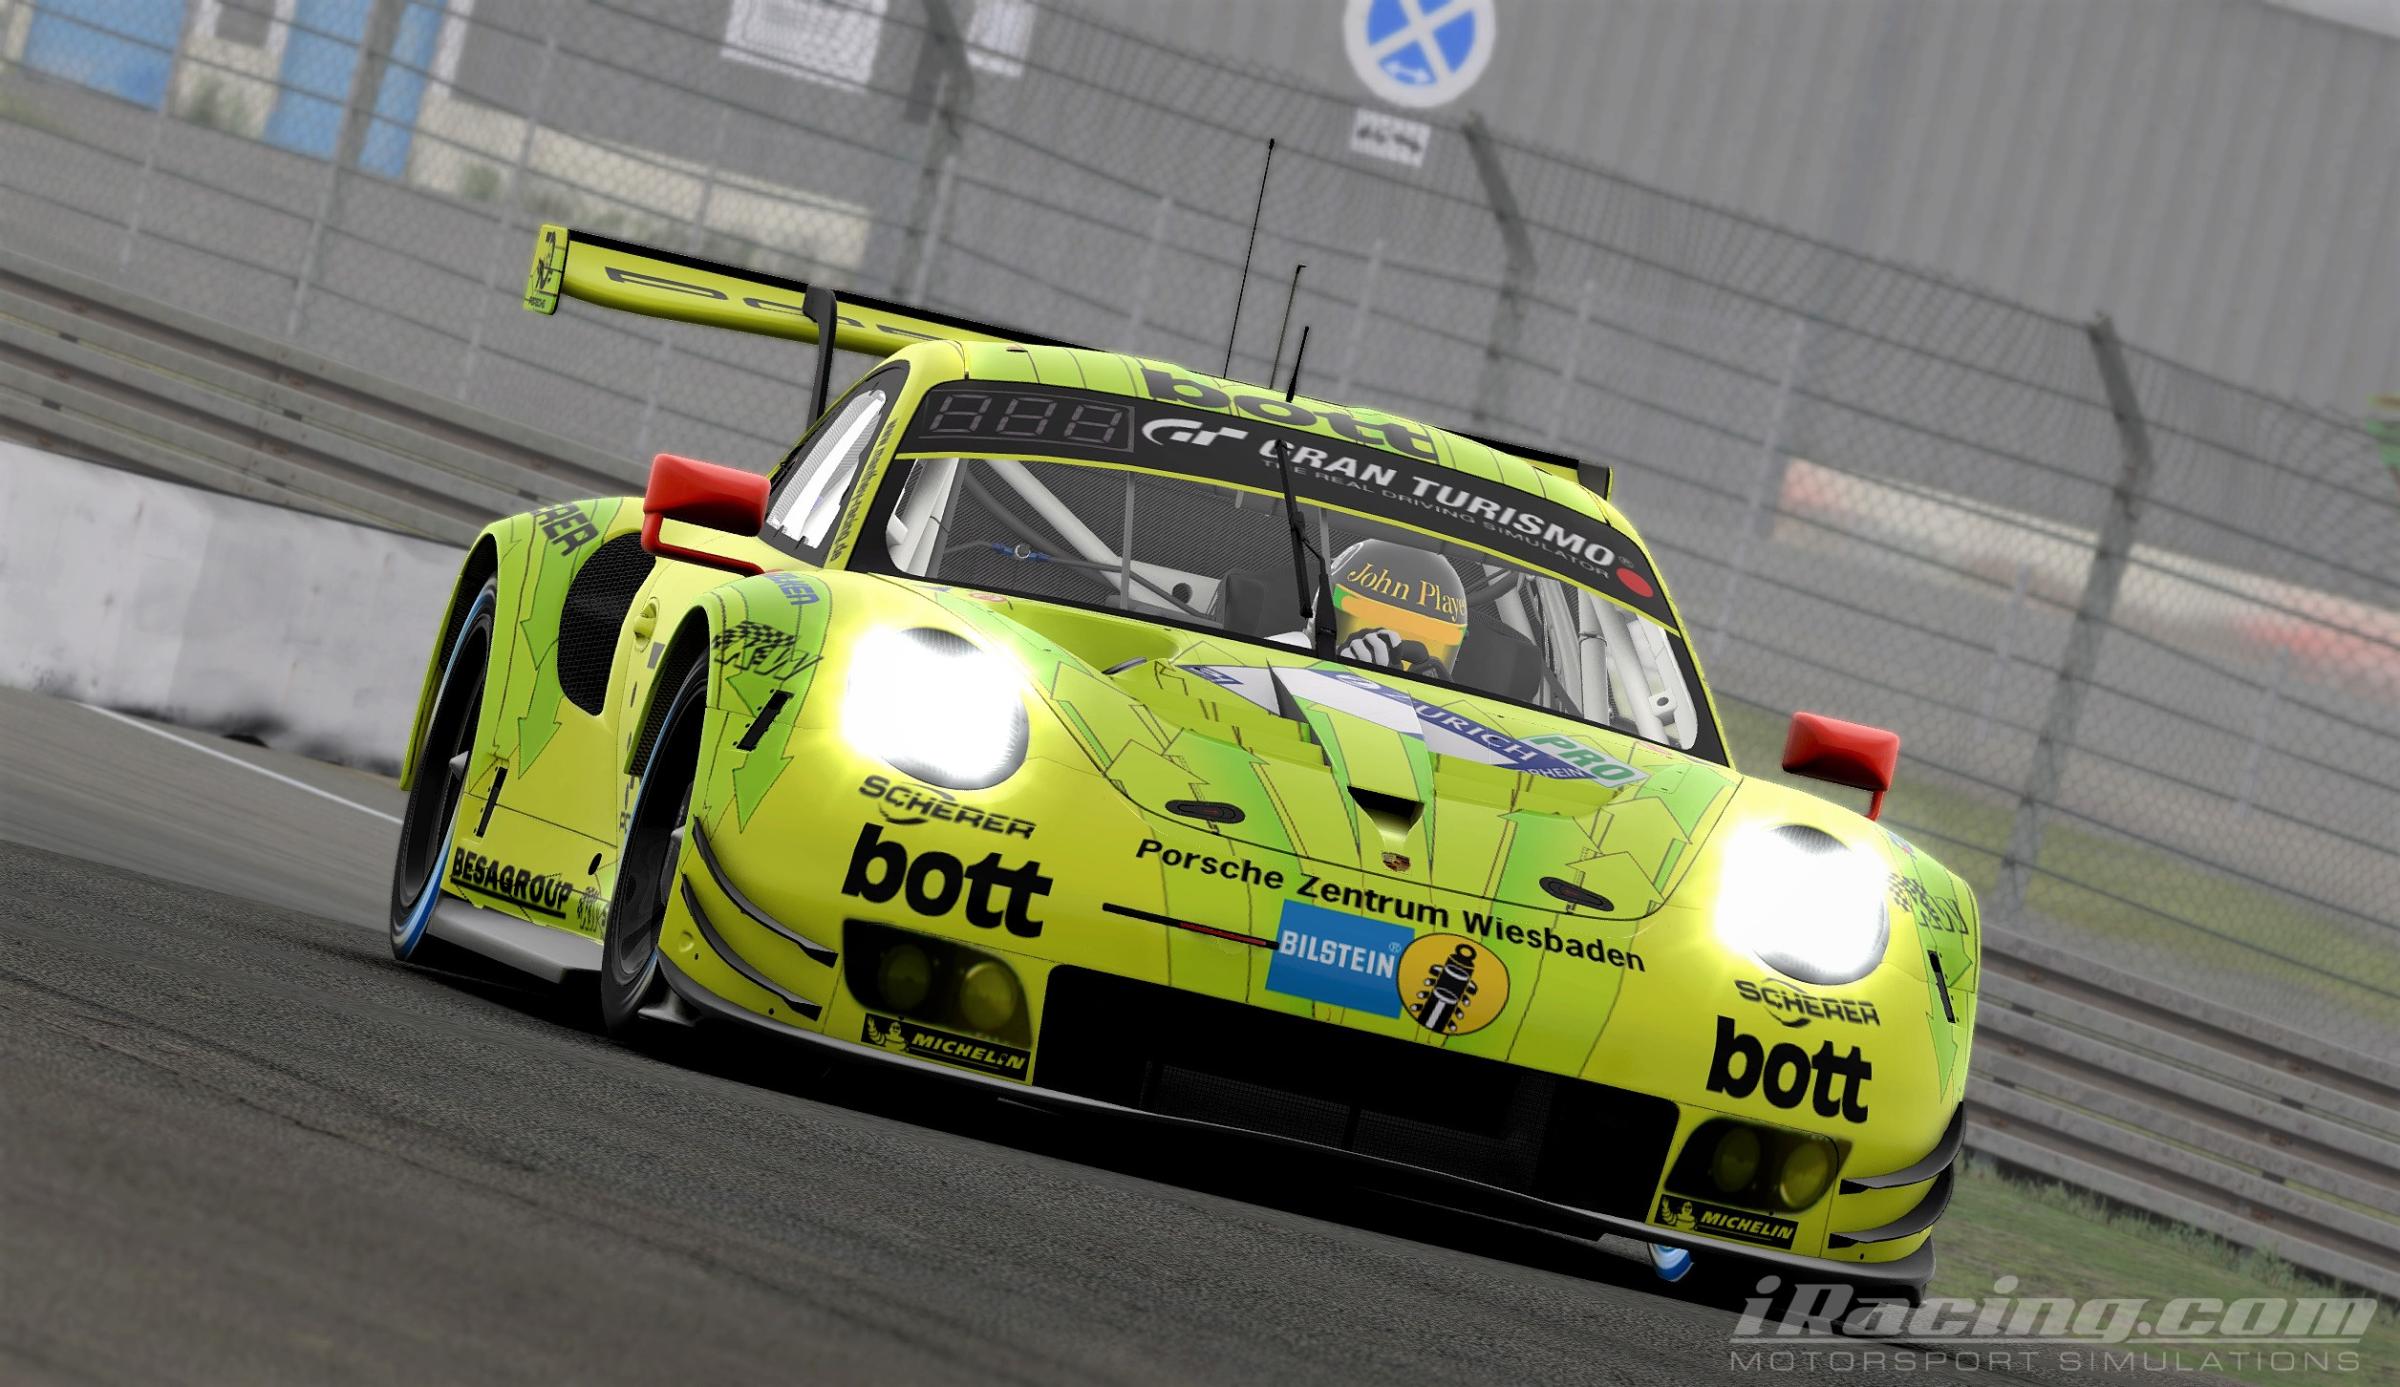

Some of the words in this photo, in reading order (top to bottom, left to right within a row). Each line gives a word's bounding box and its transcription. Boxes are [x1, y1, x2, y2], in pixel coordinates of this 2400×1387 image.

[1143, 367, 1440, 464] bott
[1258, 438, 1398, 487] GRAN
[1411, 475, 1616, 567] TURISMO
[1263, 459, 1308, 476] TE
[1315, 471, 1375, 494] REAL
[1381, 488, 1476, 525] DRIVING
[1482, 520, 1610, 580] SIMULATOR
[1346, 562, 1411, 601] John
[1416, 579, 1468, 622] Playe
[1530, 735, 1636, 781] PRO
[858, 774, 1037, 840] SCHERER
[452, 846, 573, 912] BESAGROUP
[841, 822, 1053, 938] bott
[1135, 838, 1285, 891] Porsche
[1296, 873, 1450, 929] Zentrum
[1461, 908, 1646, 974] Wiesbaden
[1279, 929, 1396, 979] BILSTEIN
[1734, 978, 1880, 1027] SCHERER
[1705, 1014, 1873, 1124] bott
[1700, 1209, 1795, 1240] MICHELIN
